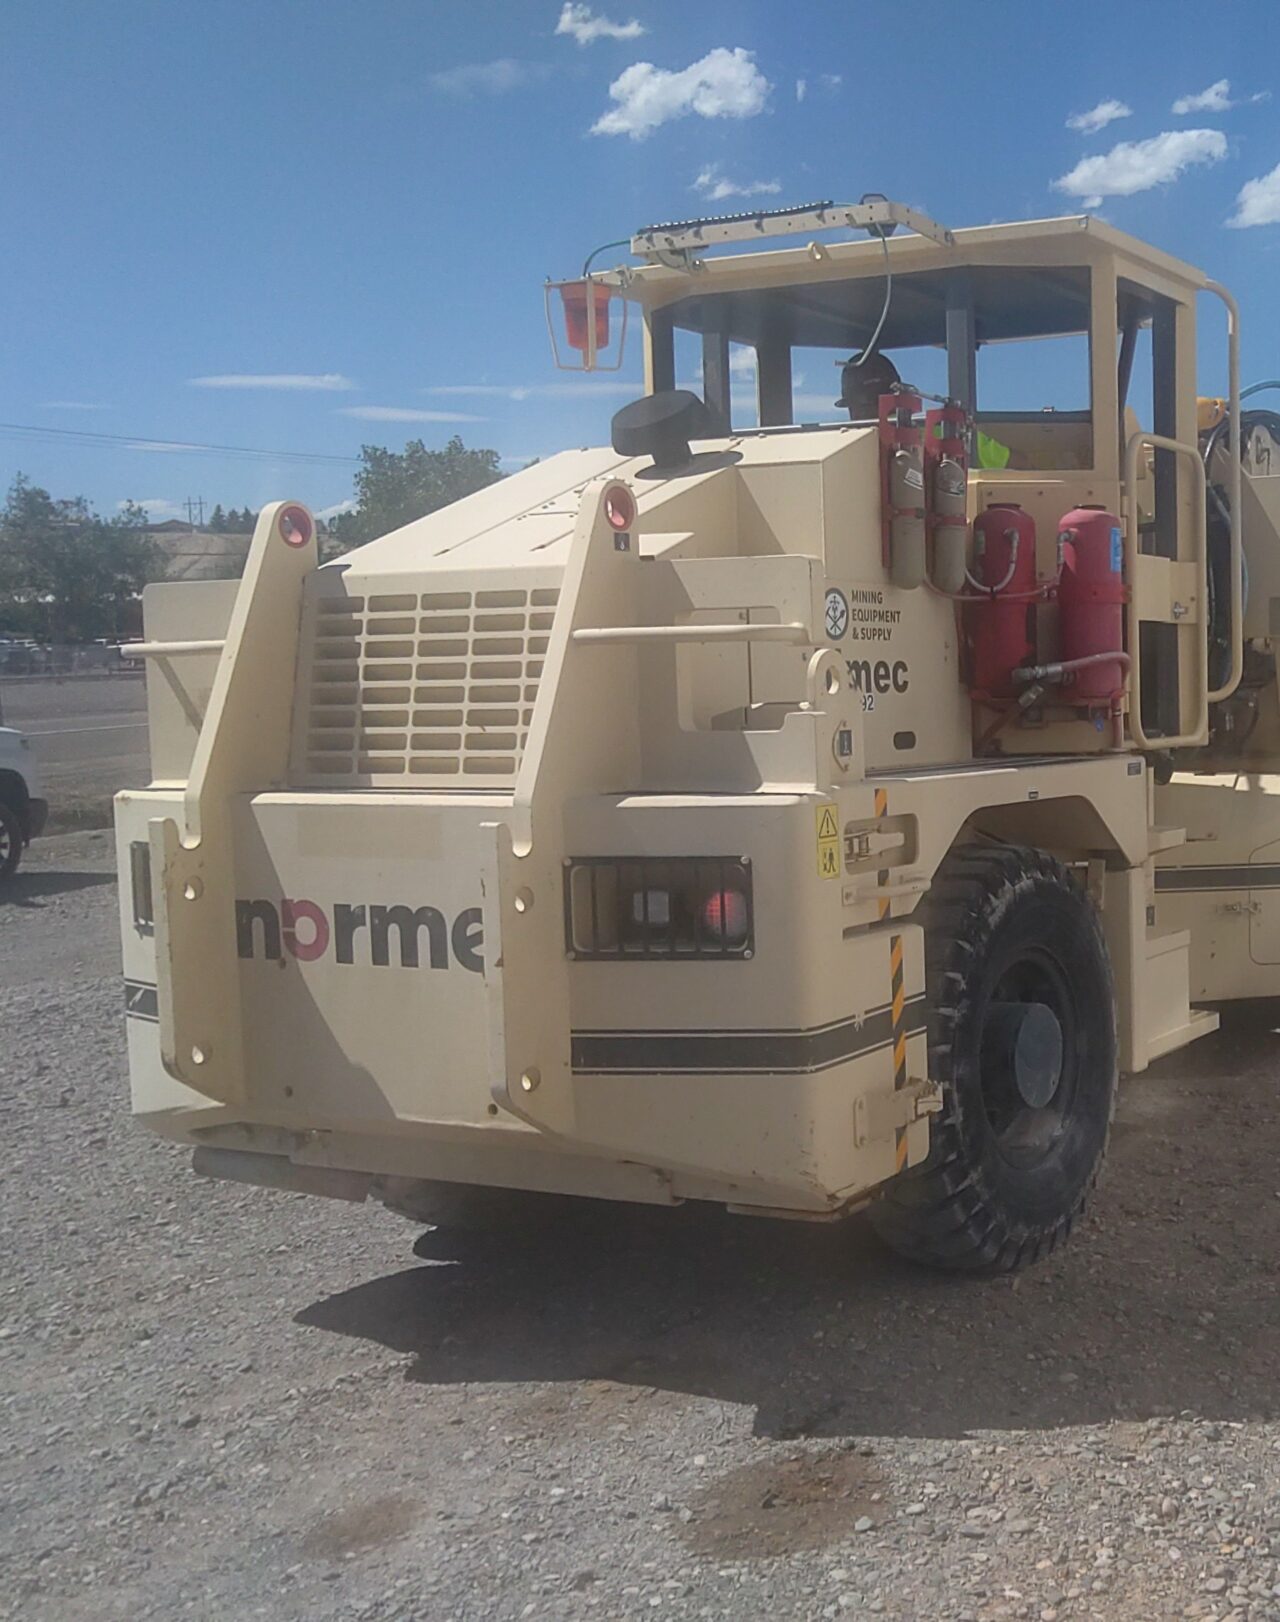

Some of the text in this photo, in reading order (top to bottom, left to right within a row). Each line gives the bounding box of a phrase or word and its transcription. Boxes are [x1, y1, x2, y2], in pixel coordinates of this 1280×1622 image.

[851, 589, 884, 604] MINING
[852, 608, 902, 624] EQUIPMENT
[852, 626, 893, 641] & SUPPLY
[844, 660, 909, 694] mec
